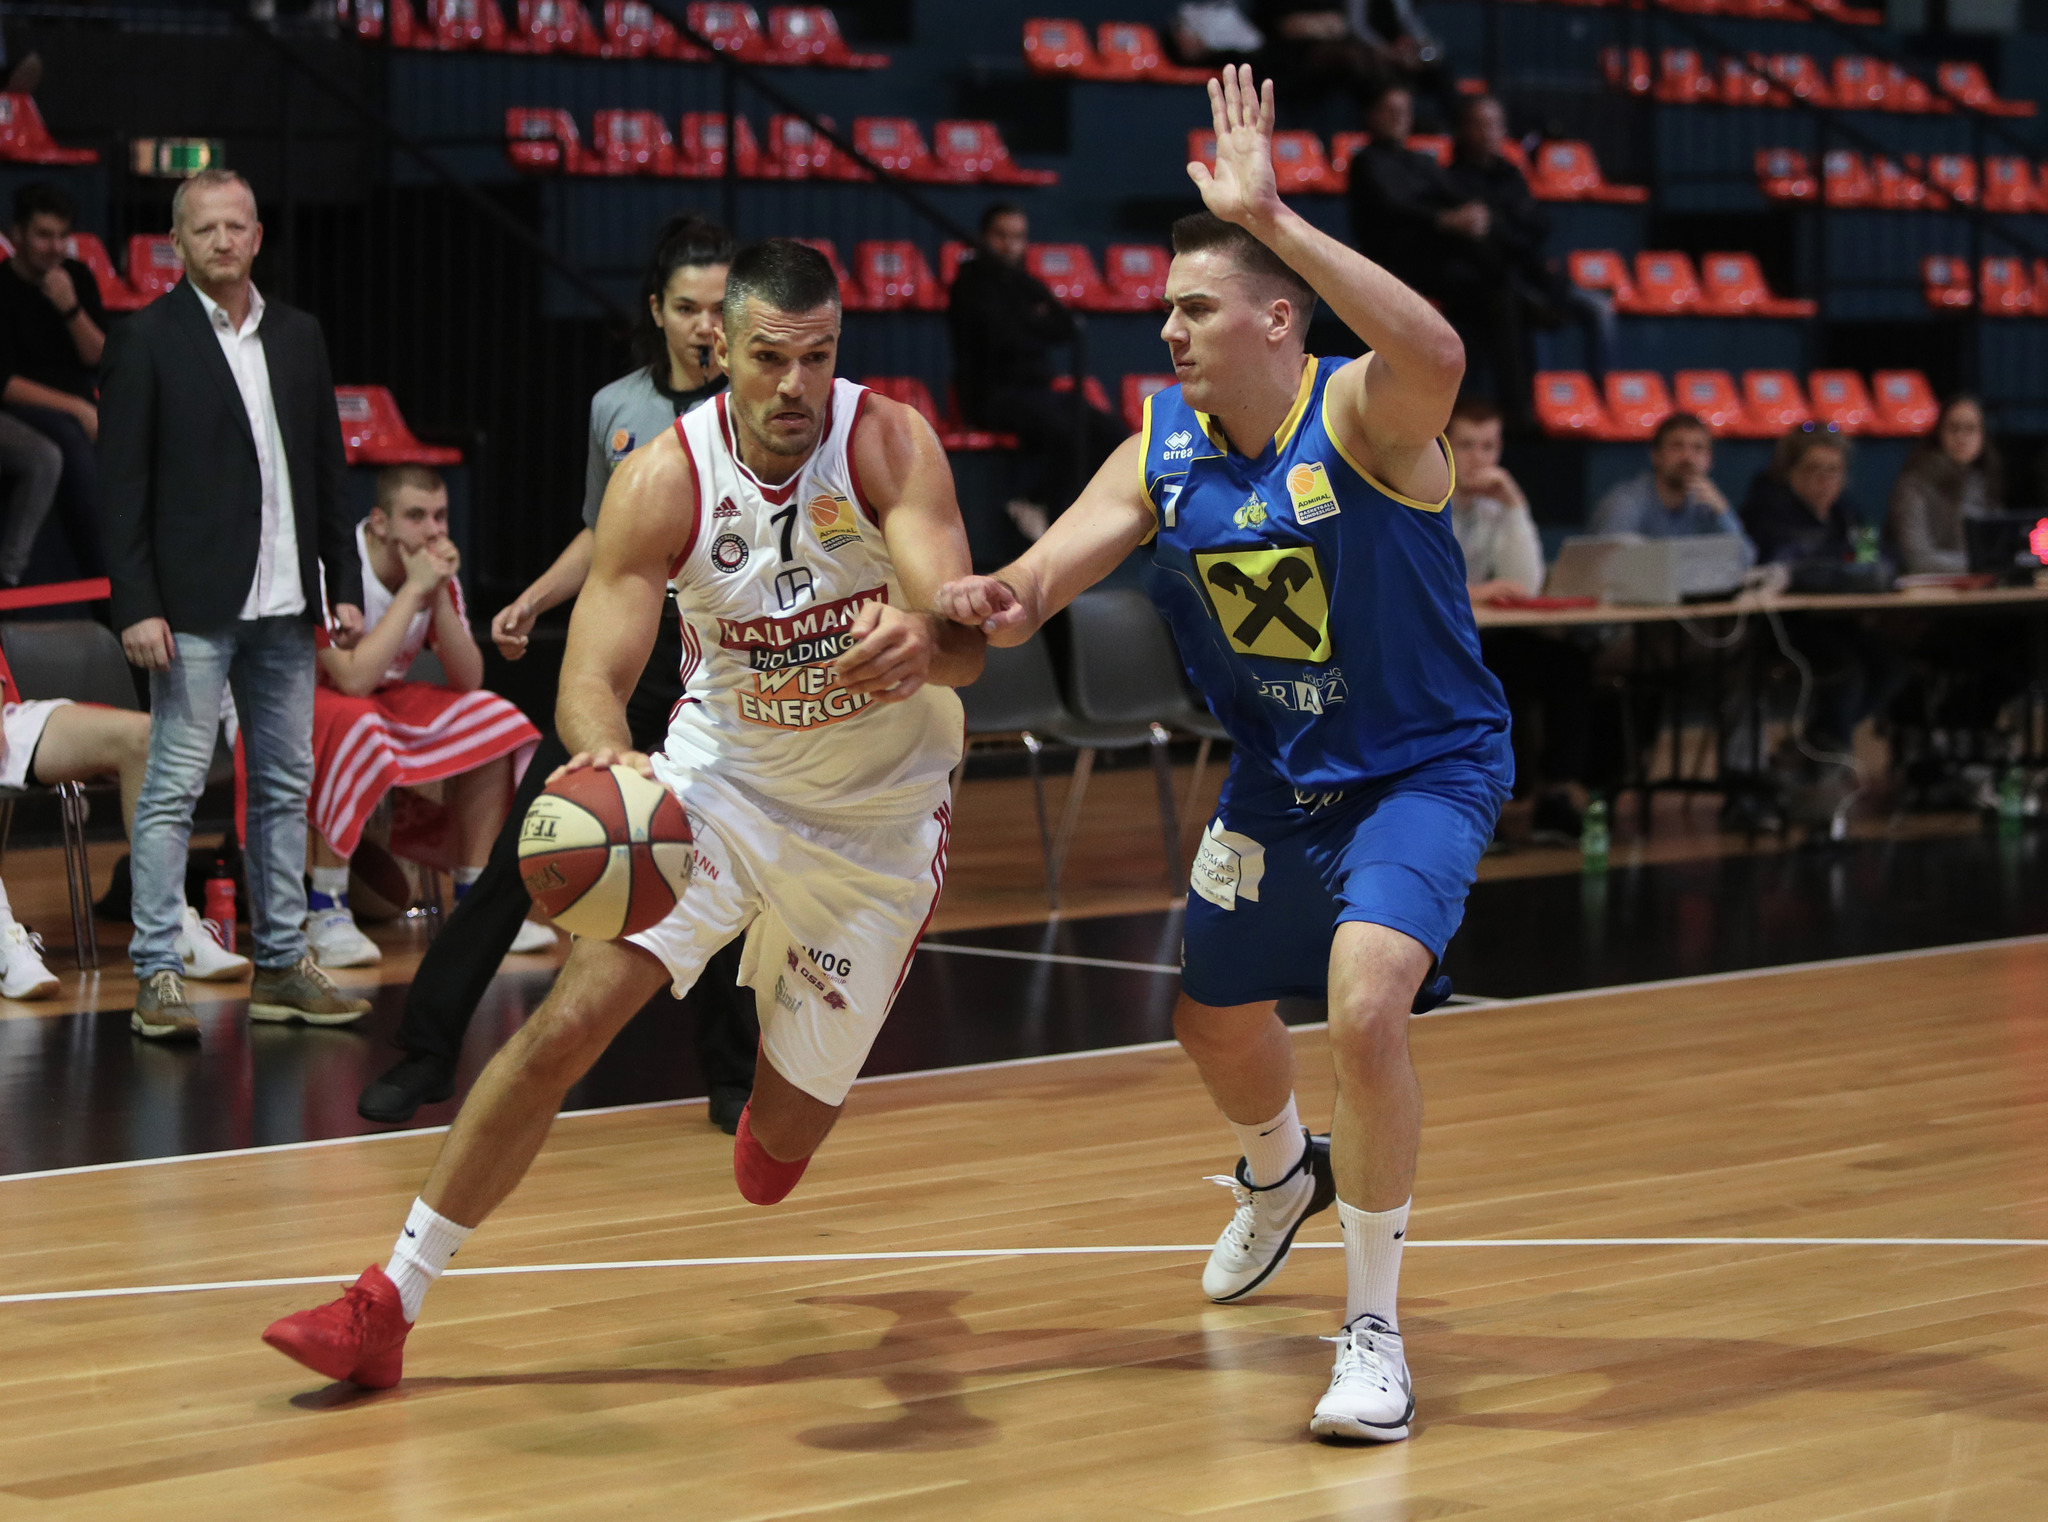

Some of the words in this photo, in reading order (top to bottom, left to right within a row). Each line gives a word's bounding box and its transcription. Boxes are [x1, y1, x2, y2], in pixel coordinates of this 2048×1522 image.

[1163, 484, 1183, 528] 7
[1298, 493, 1331, 508] ADMIRAL
[1299, 502, 1335, 517] BASKETBALL
[713, 510, 742, 519] adidas
[1300, 506, 1336, 521] BUNDESLIGA
[755, 632, 855, 669] HOLDING
[1302, 667, 1342, 687] HOLDING
[1201, 844, 1235, 873] OMAS
[1195, 857, 1234, 887] ORENZ
